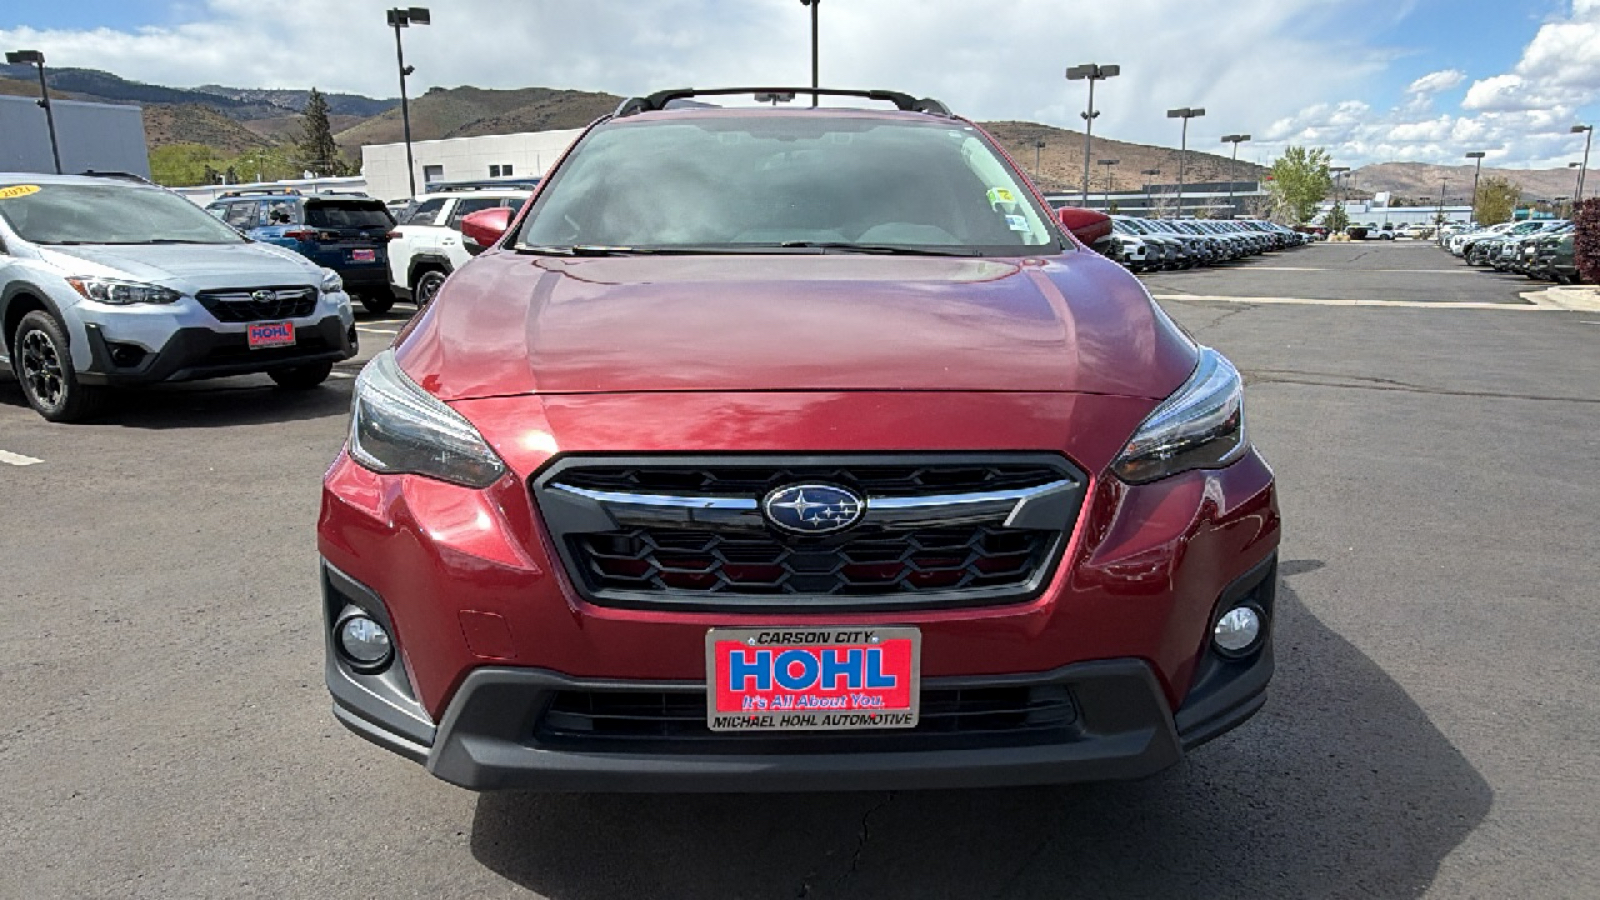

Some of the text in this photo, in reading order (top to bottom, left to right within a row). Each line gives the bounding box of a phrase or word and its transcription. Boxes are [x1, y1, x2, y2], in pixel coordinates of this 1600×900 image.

[252, 326, 290, 339] HOHL
[757, 631, 874, 644] CARSON CITY
[729, 649, 896, 691] HOHL
[742, 693, 885, 708] It's All About You.
[713, 713, 913, 728] MICHAEL HOHL AUTOMOTIVE
